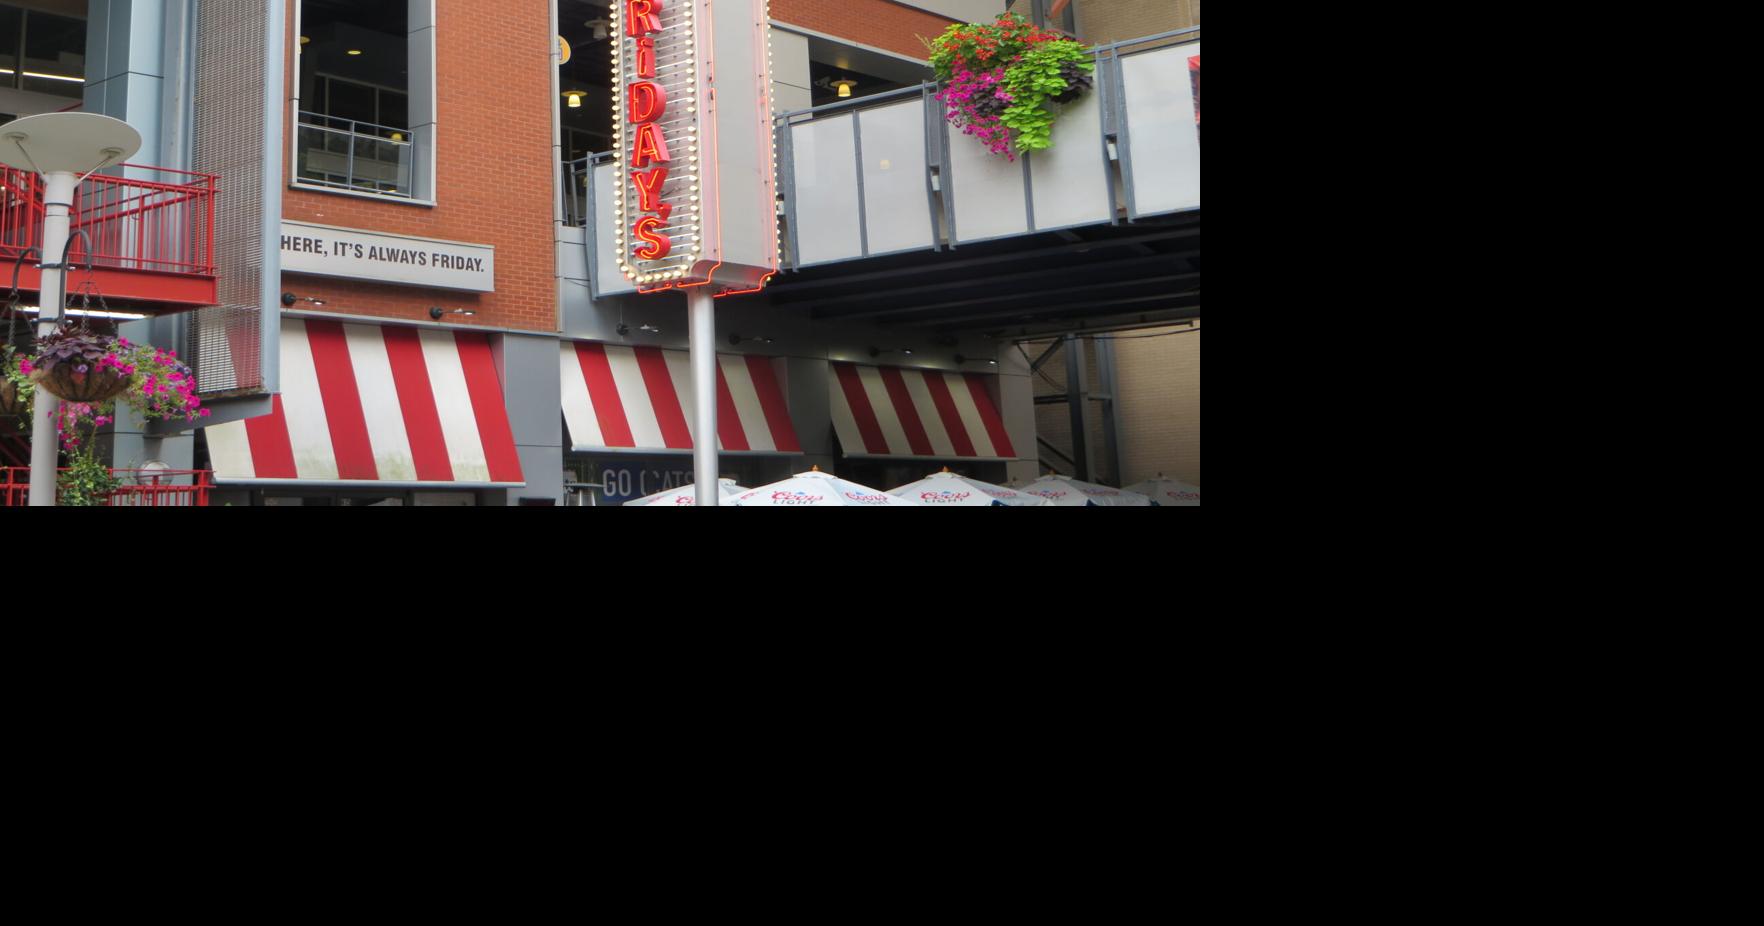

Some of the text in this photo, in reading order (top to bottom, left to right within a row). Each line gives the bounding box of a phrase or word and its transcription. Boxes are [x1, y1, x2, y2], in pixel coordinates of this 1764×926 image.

[281, 235, 485, 273] HERE, IT'S ALWAYS FRIDAY.
[603, 469, 631, 497] GO
